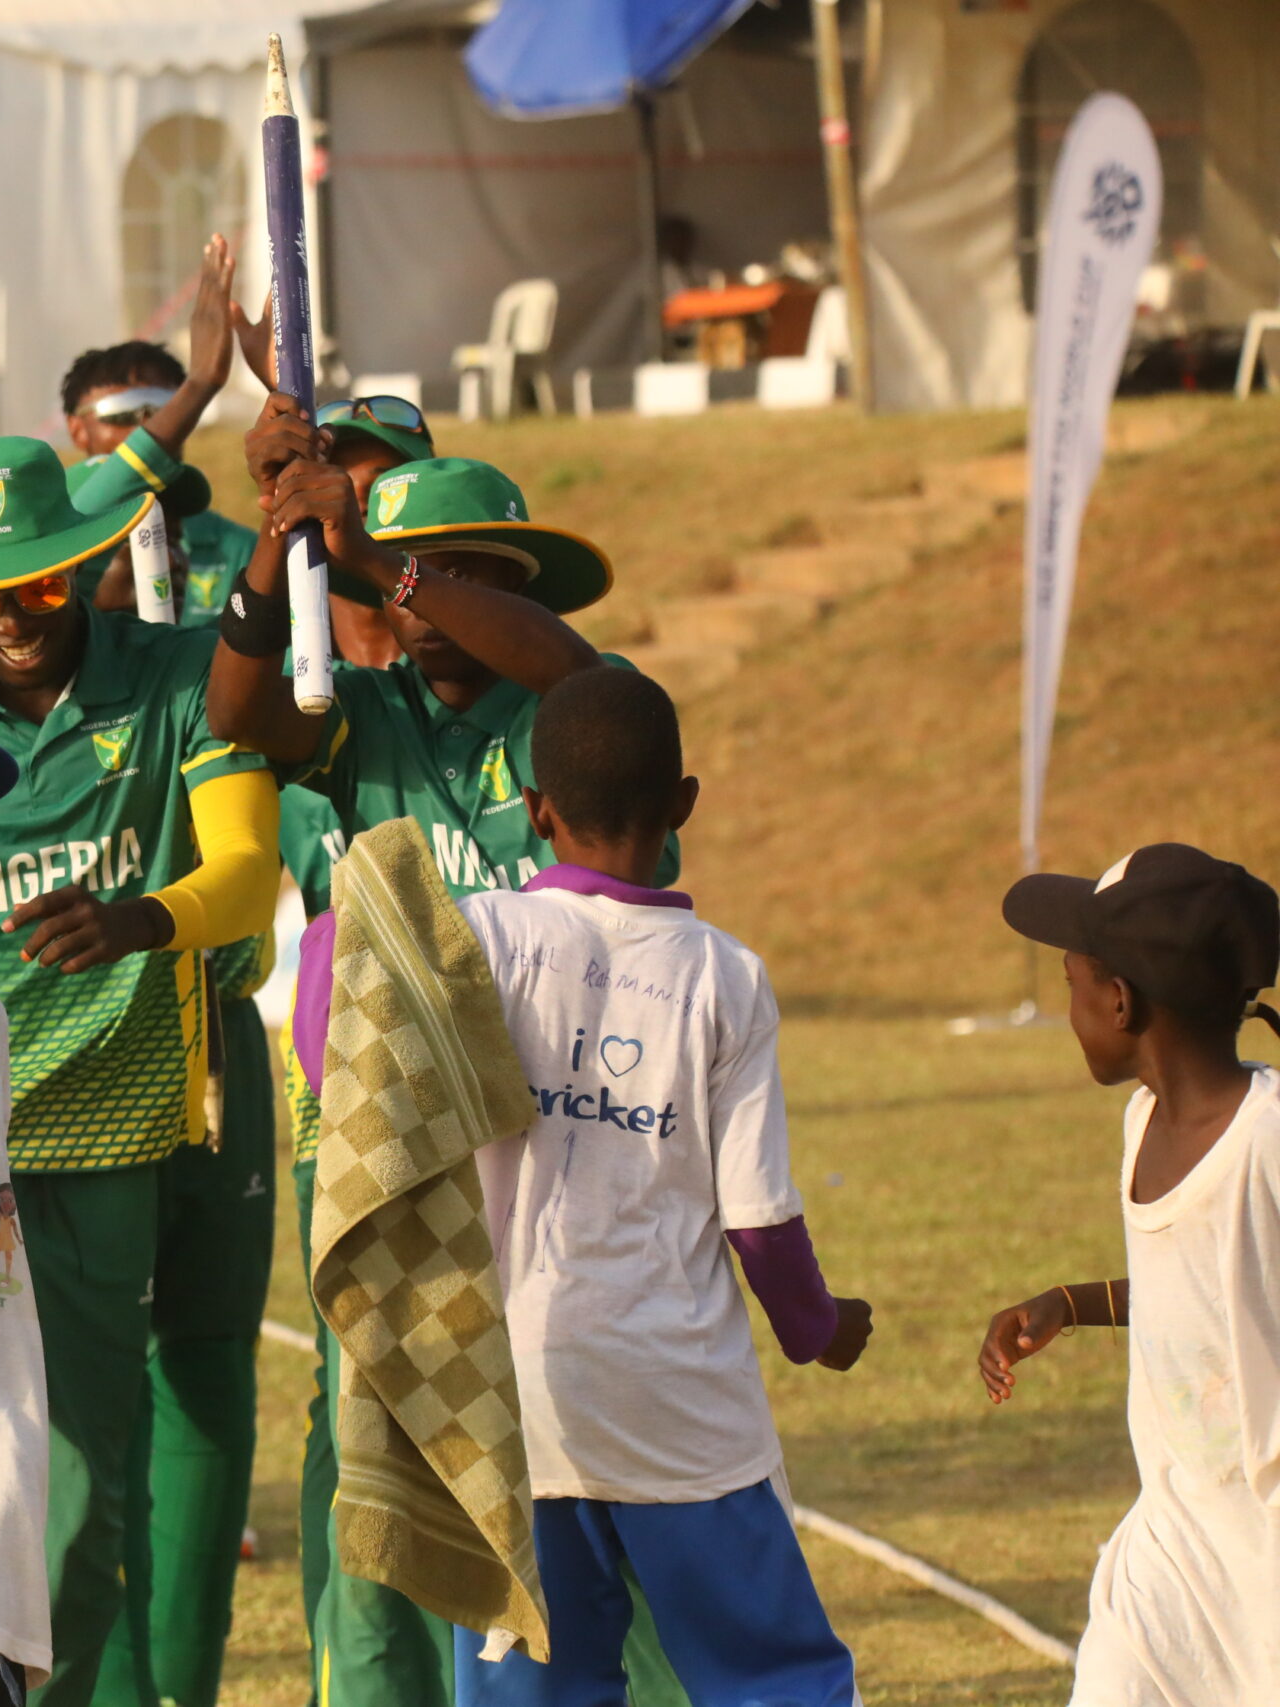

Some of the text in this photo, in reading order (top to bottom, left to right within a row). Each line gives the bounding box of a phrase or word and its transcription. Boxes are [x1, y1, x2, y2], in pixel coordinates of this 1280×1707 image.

[482, 796, 523, 816] FEDERATIO
[572, 1028, 585, 1071] i
[528, 1084, 678, 1139] ricket
